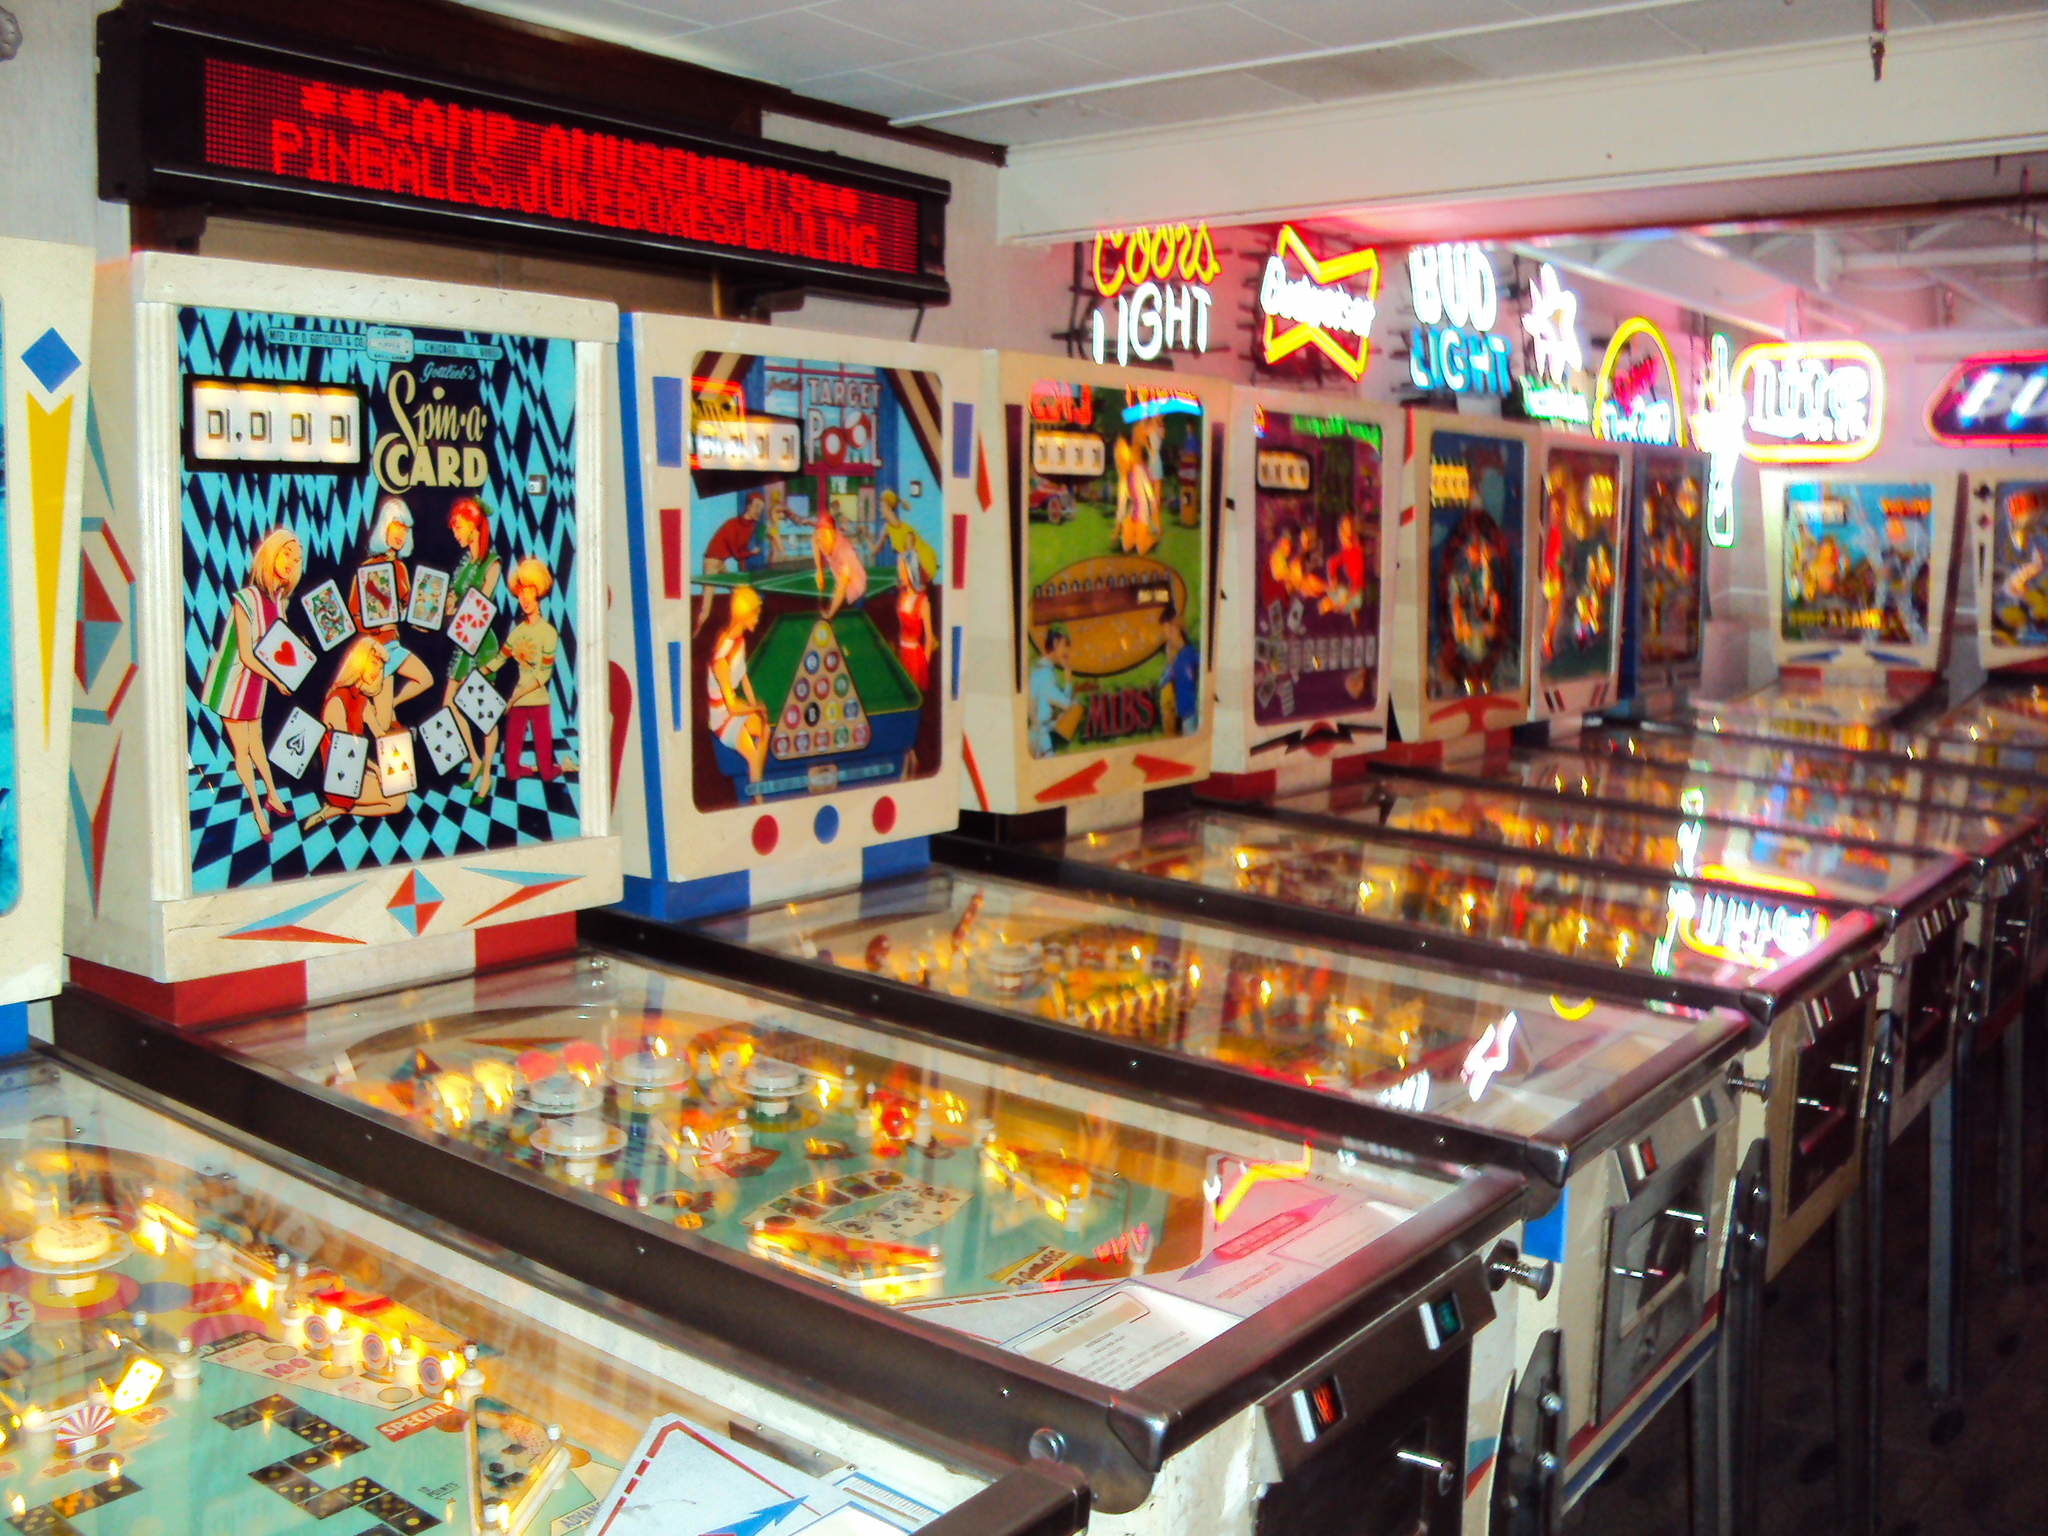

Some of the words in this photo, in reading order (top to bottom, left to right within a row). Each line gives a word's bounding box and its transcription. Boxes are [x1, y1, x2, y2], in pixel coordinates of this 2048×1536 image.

[1408, 242, 1498, 332] BUD
[806, 377, 885, 409] TARGET
[1410, 328, 1513, 396] LIGHT
[372, 432, 489, 495] CARD
[805, 407, 885, 468] POOL
[379, 1403, 453, 1436] SPECIAL
